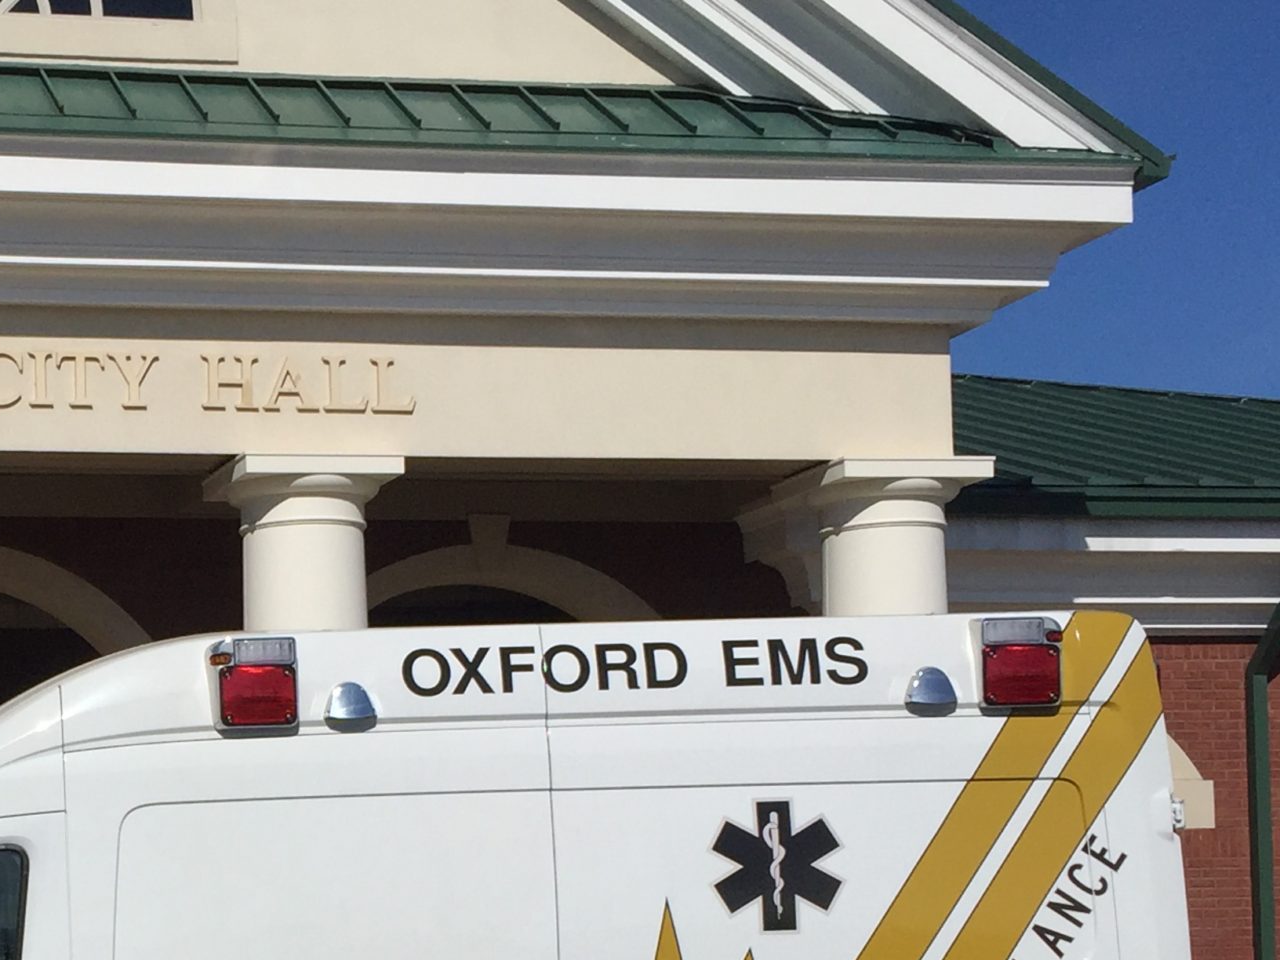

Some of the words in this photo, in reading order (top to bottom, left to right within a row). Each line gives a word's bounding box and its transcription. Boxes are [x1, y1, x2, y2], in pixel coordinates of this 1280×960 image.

[201, 354, 417, 414] HALL
[402, 642, 688, 697] OXFORD
[721, 636, 869, 686] EMS
